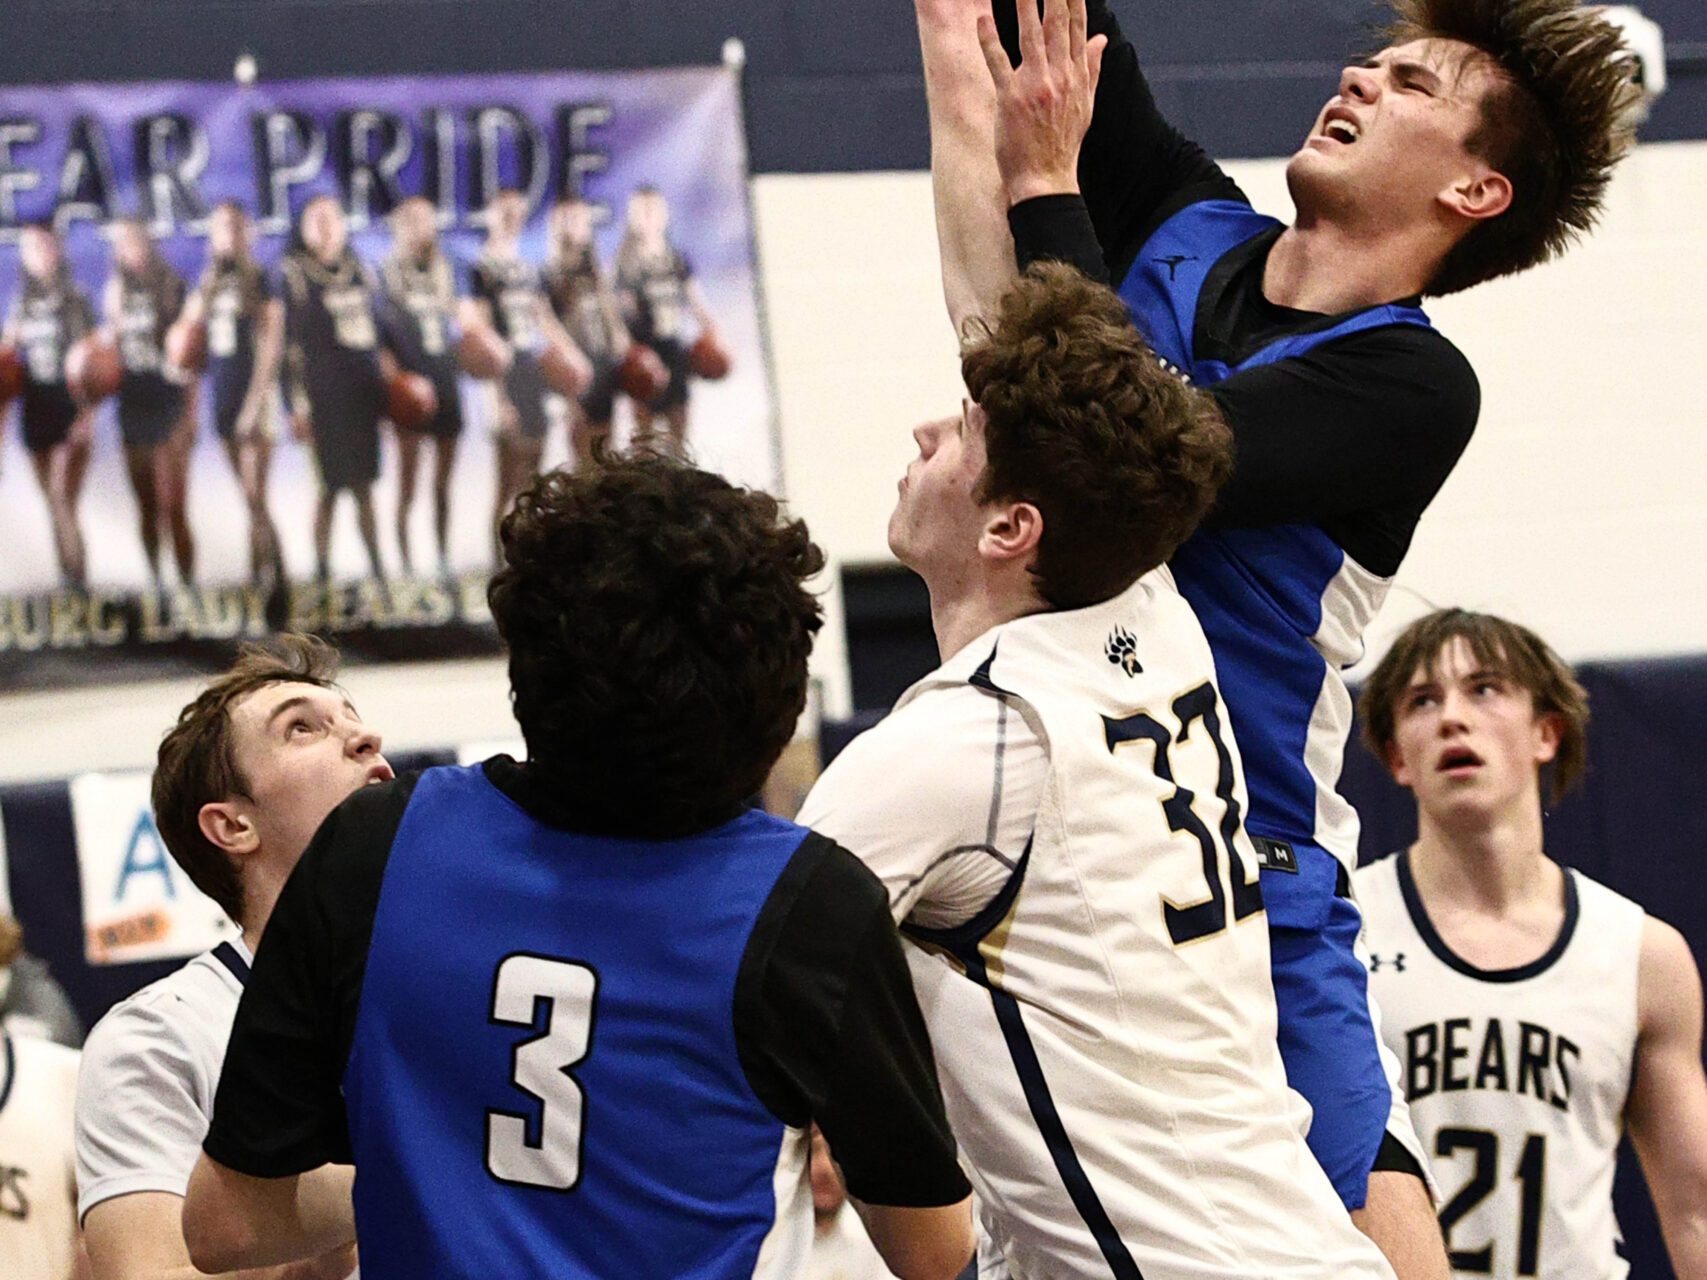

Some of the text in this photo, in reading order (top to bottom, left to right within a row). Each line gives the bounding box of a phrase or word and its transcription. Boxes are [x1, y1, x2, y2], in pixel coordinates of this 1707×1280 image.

[249, 103, 614, 232] PRIDE
[1099, 677, 1265, 950] 32
[482, 949, 599, 1193] 3
[1404, 1017, 1581, 1112] BEARS
[1434, 1124, 1547, 1277] 21
